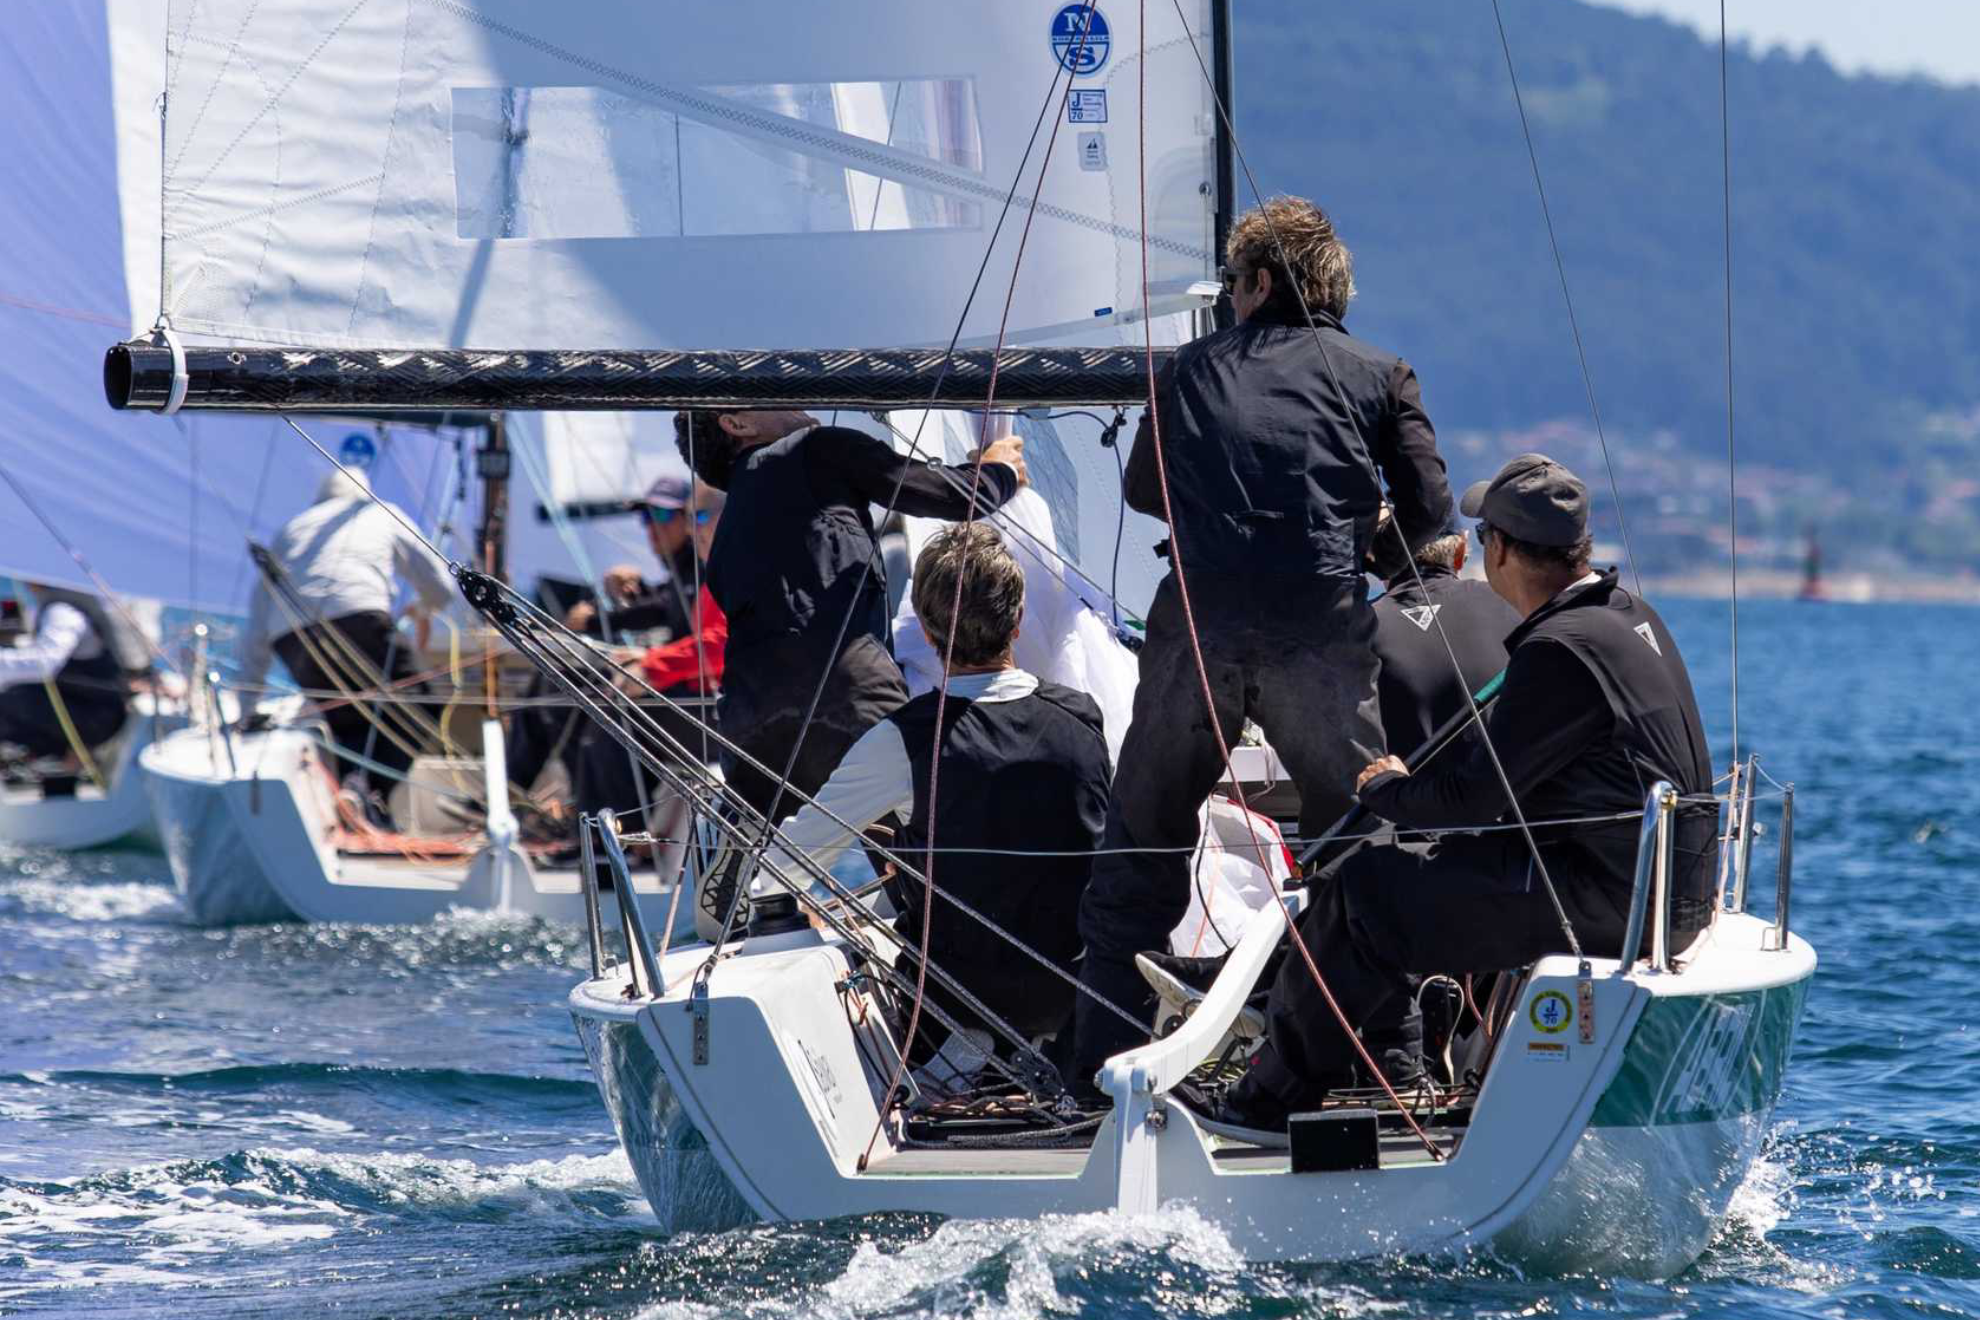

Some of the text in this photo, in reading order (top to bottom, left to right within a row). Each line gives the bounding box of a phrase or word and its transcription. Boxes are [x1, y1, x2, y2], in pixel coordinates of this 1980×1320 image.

[1064, 12, 1091, 31] N
[1068, 46, 1096, 66] S
[1072, 92, 1081, 107] J
[1072, 111, 1083, 120] 70
